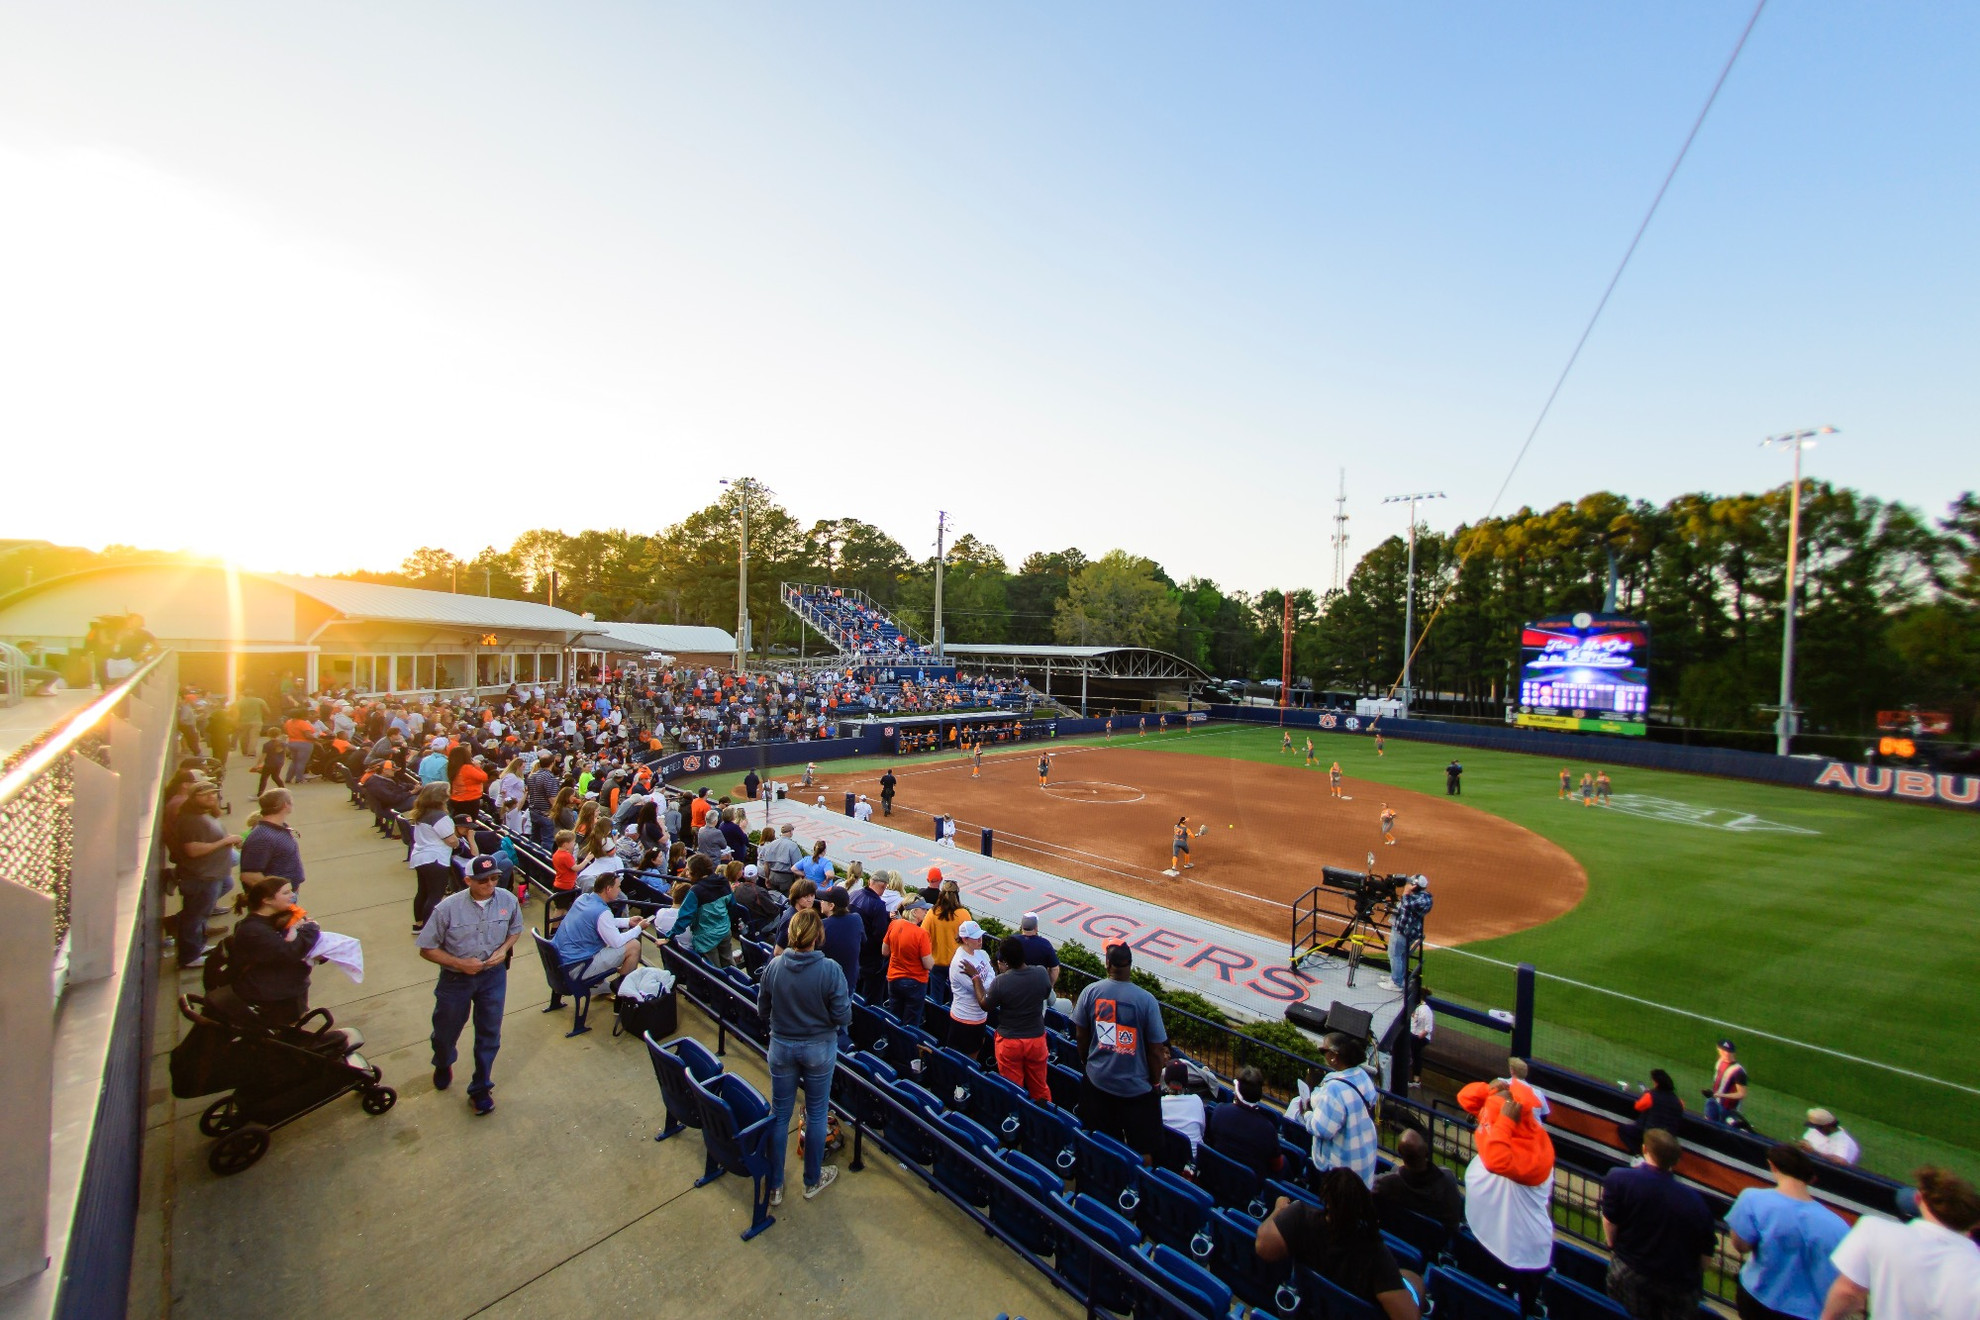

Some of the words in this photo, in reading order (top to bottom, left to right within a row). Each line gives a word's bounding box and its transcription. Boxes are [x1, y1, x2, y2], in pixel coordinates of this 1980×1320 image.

[708, 754, 721, 769] SEC
[1815, 762, 1980, 804] AUBU
[745, 807, 866, 846] HOME
[844, 839, 929, 862] OF
[908, 855, 1036, 904] THE
[1025, 891, 1323, 1004] TIGERS
